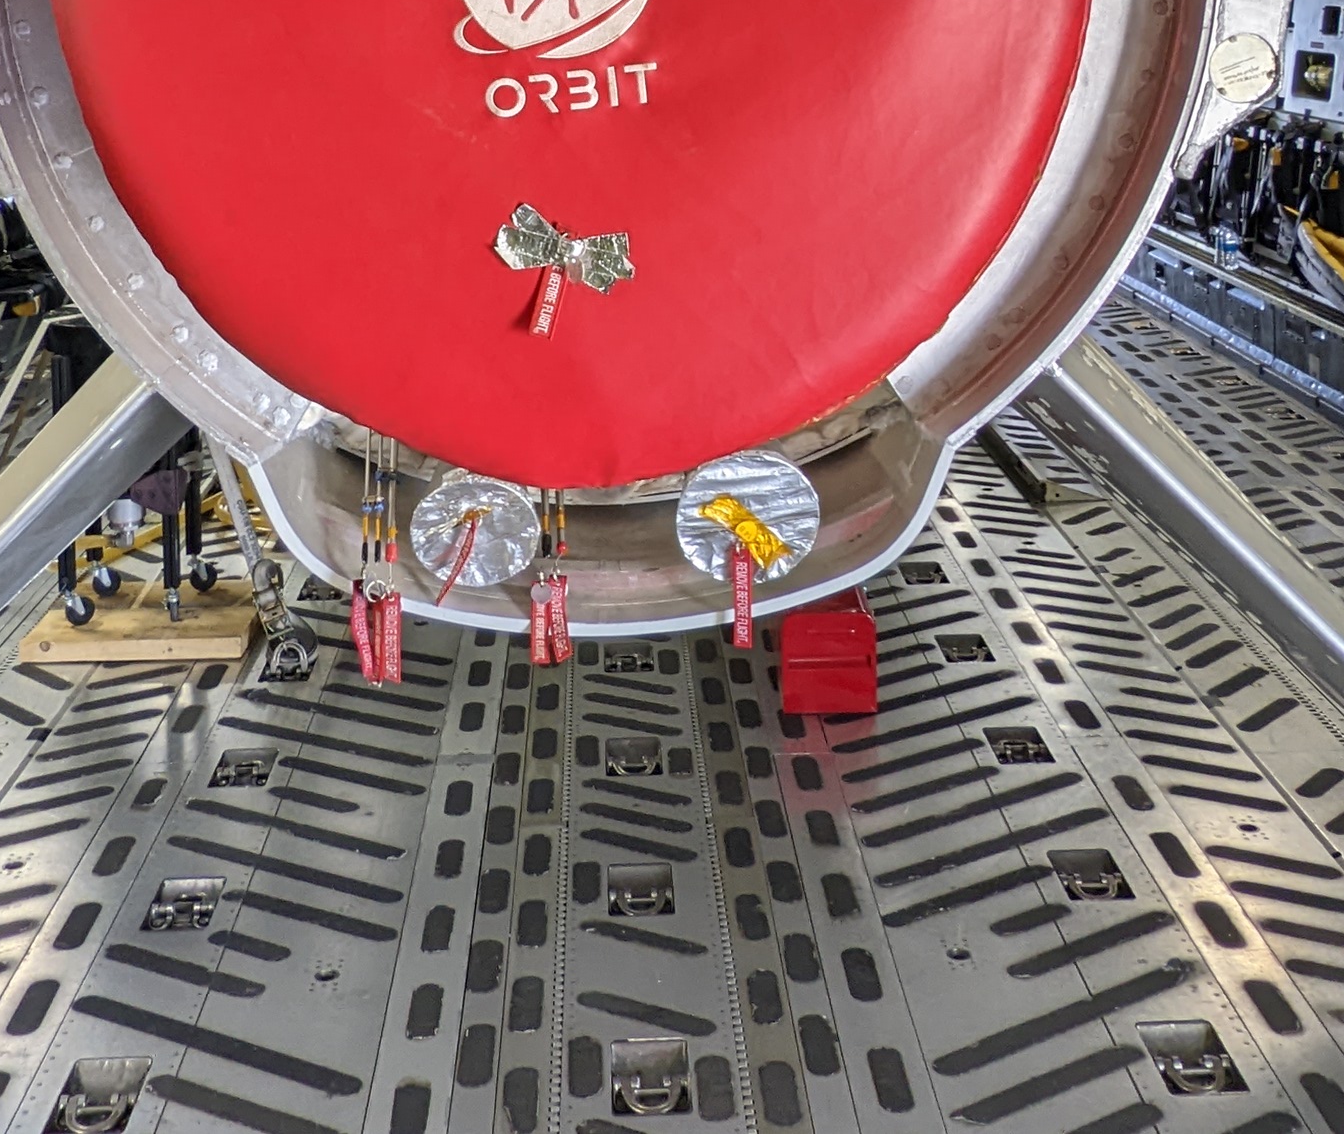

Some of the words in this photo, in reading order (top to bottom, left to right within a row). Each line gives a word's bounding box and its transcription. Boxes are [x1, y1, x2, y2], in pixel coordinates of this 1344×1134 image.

[485, 62, 657, 118] ORBIT
[543, 272, 562, 304] BEFORE
[736, 561, 748, 591] REMOVE
[551, 586, 564, 613] REMOVE
[736, 591, 749, 618] BEFORE
[354, 617, 369, 644] BEFORE
[385, 605, 397, 635] REMOVE
[535, 617, 545, 639] BEFORE
